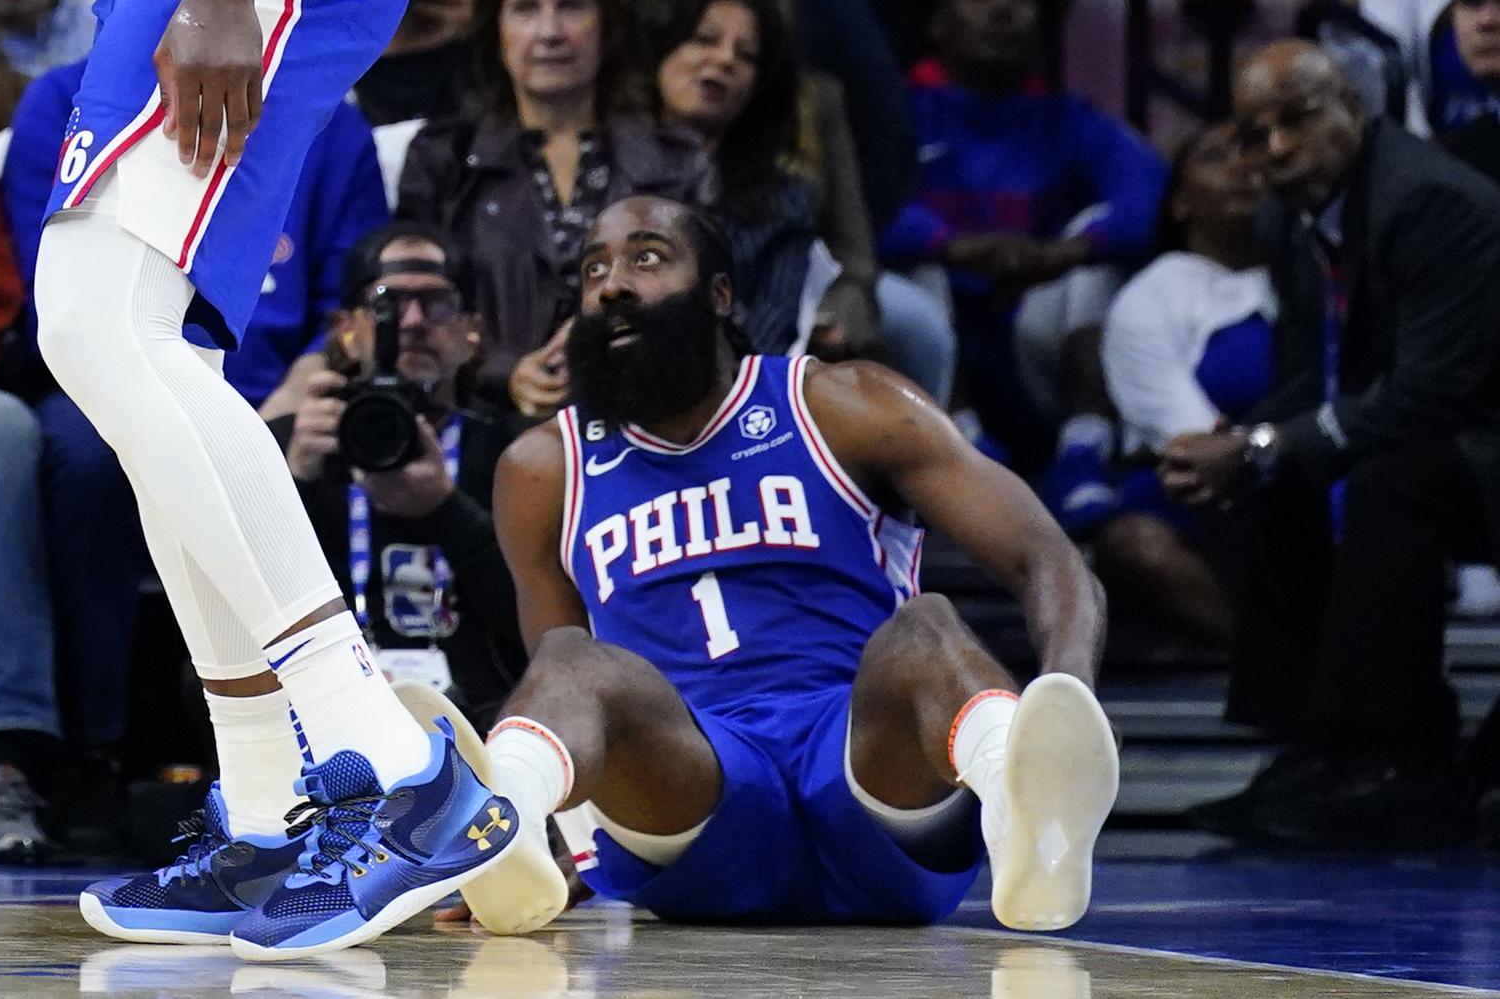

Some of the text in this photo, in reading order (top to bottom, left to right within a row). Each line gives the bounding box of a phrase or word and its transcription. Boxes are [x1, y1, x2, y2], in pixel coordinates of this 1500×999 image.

[585, 419, 607, 441] 6
[730, 430, 794, 461] crypto.com
[583, 473, 821, 605] PHILA
[690, 570, 741, 661] 1
